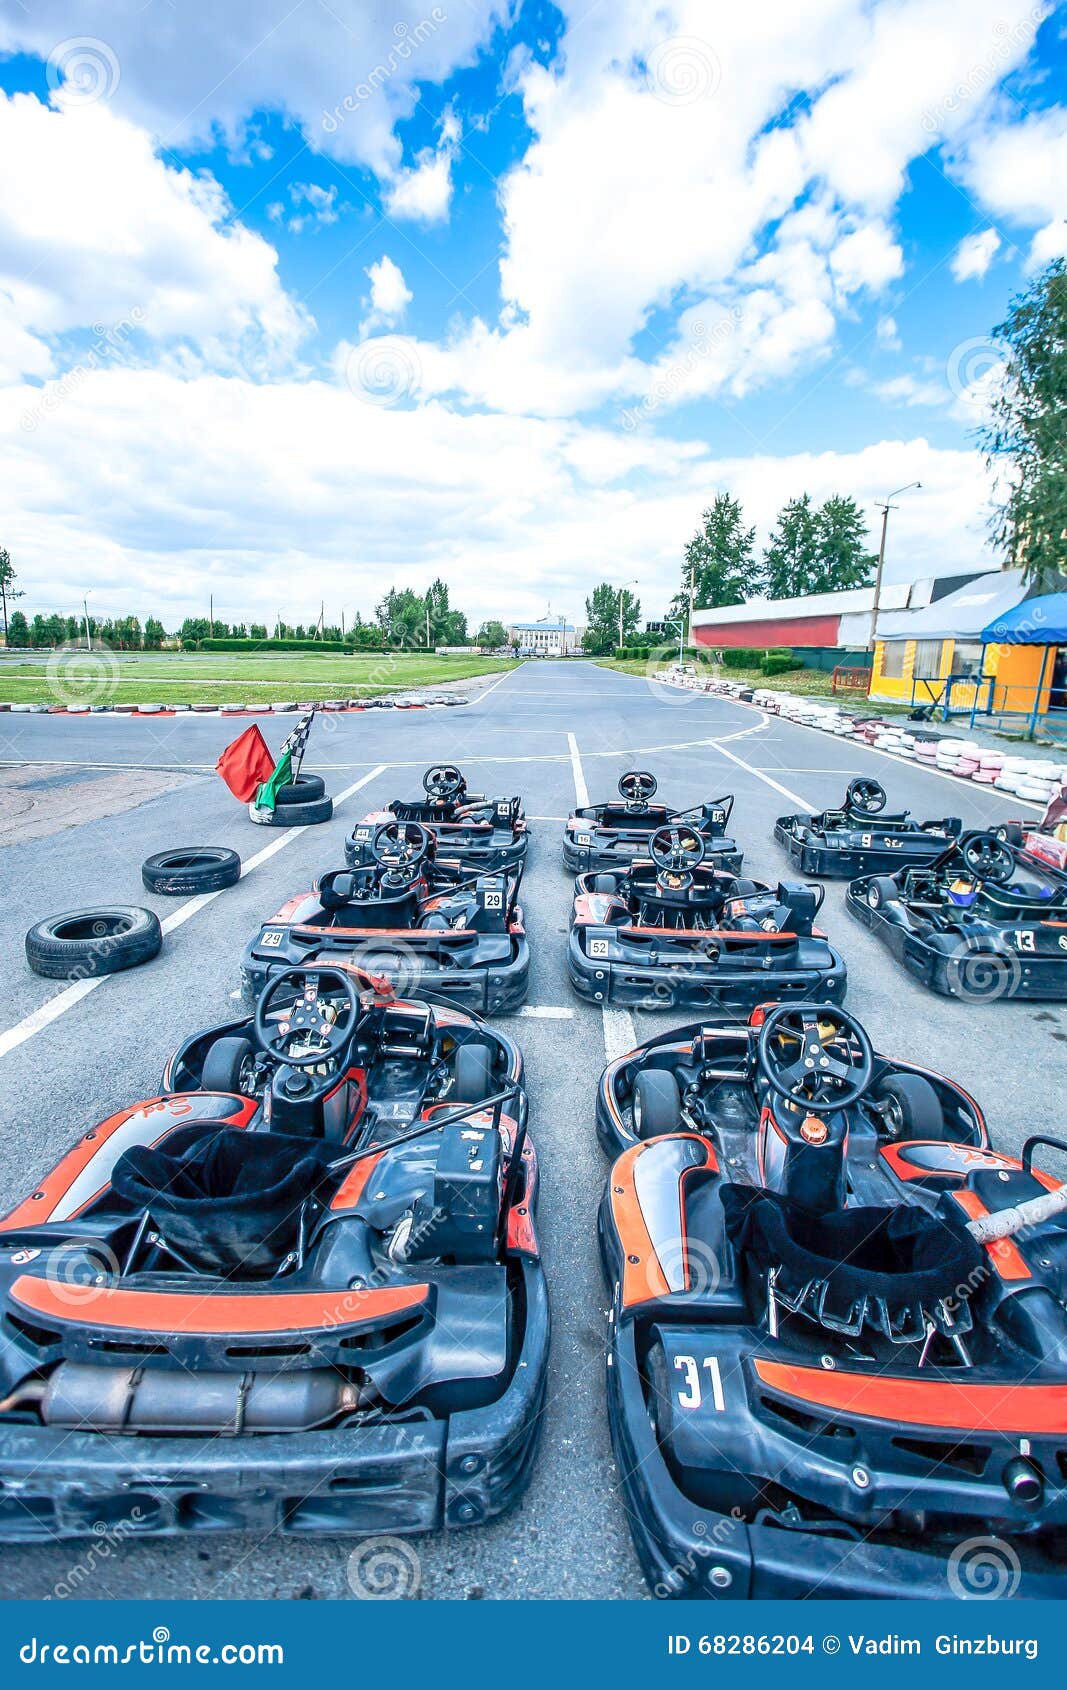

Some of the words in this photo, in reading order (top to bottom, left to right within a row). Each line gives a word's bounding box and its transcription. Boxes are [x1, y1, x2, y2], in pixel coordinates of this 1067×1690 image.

[487, 894, 500, 906] 29
[263, 933, 281, 945] 29
[1014, 930, 1036, 951] 13
[593, 942, 606, 953] 52
[673, 1355, 726, 1411] 31
